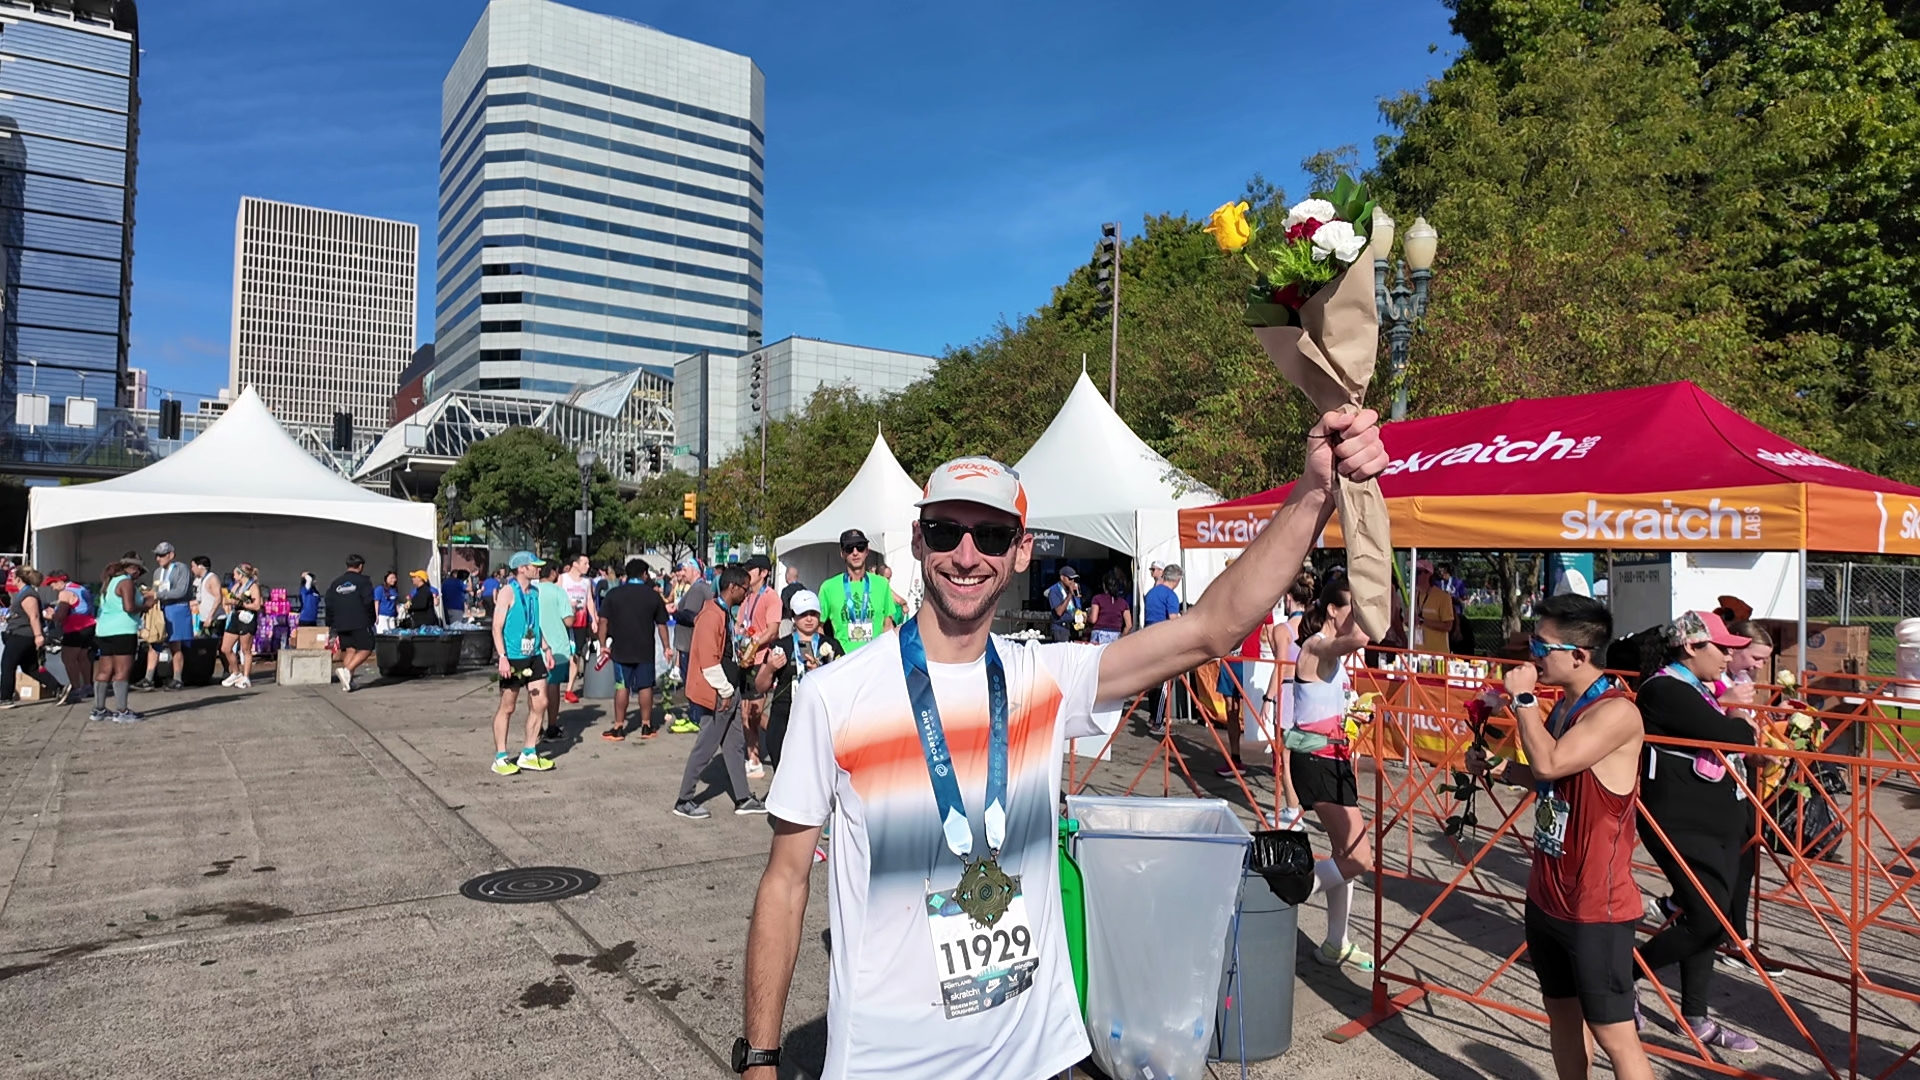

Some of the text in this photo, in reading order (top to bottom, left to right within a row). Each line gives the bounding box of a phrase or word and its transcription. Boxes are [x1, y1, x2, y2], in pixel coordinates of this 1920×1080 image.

[1566, 436, 1602, 459] LABS
[946, 462, 1001, 476] BROOKS
[1560, 498, 1762, 540] skratch LABS
[921, 710, 940, 762] PORTLAND
[940, 925, 1031, 975] 11929
[950, 988, 978, 1001] skratch
